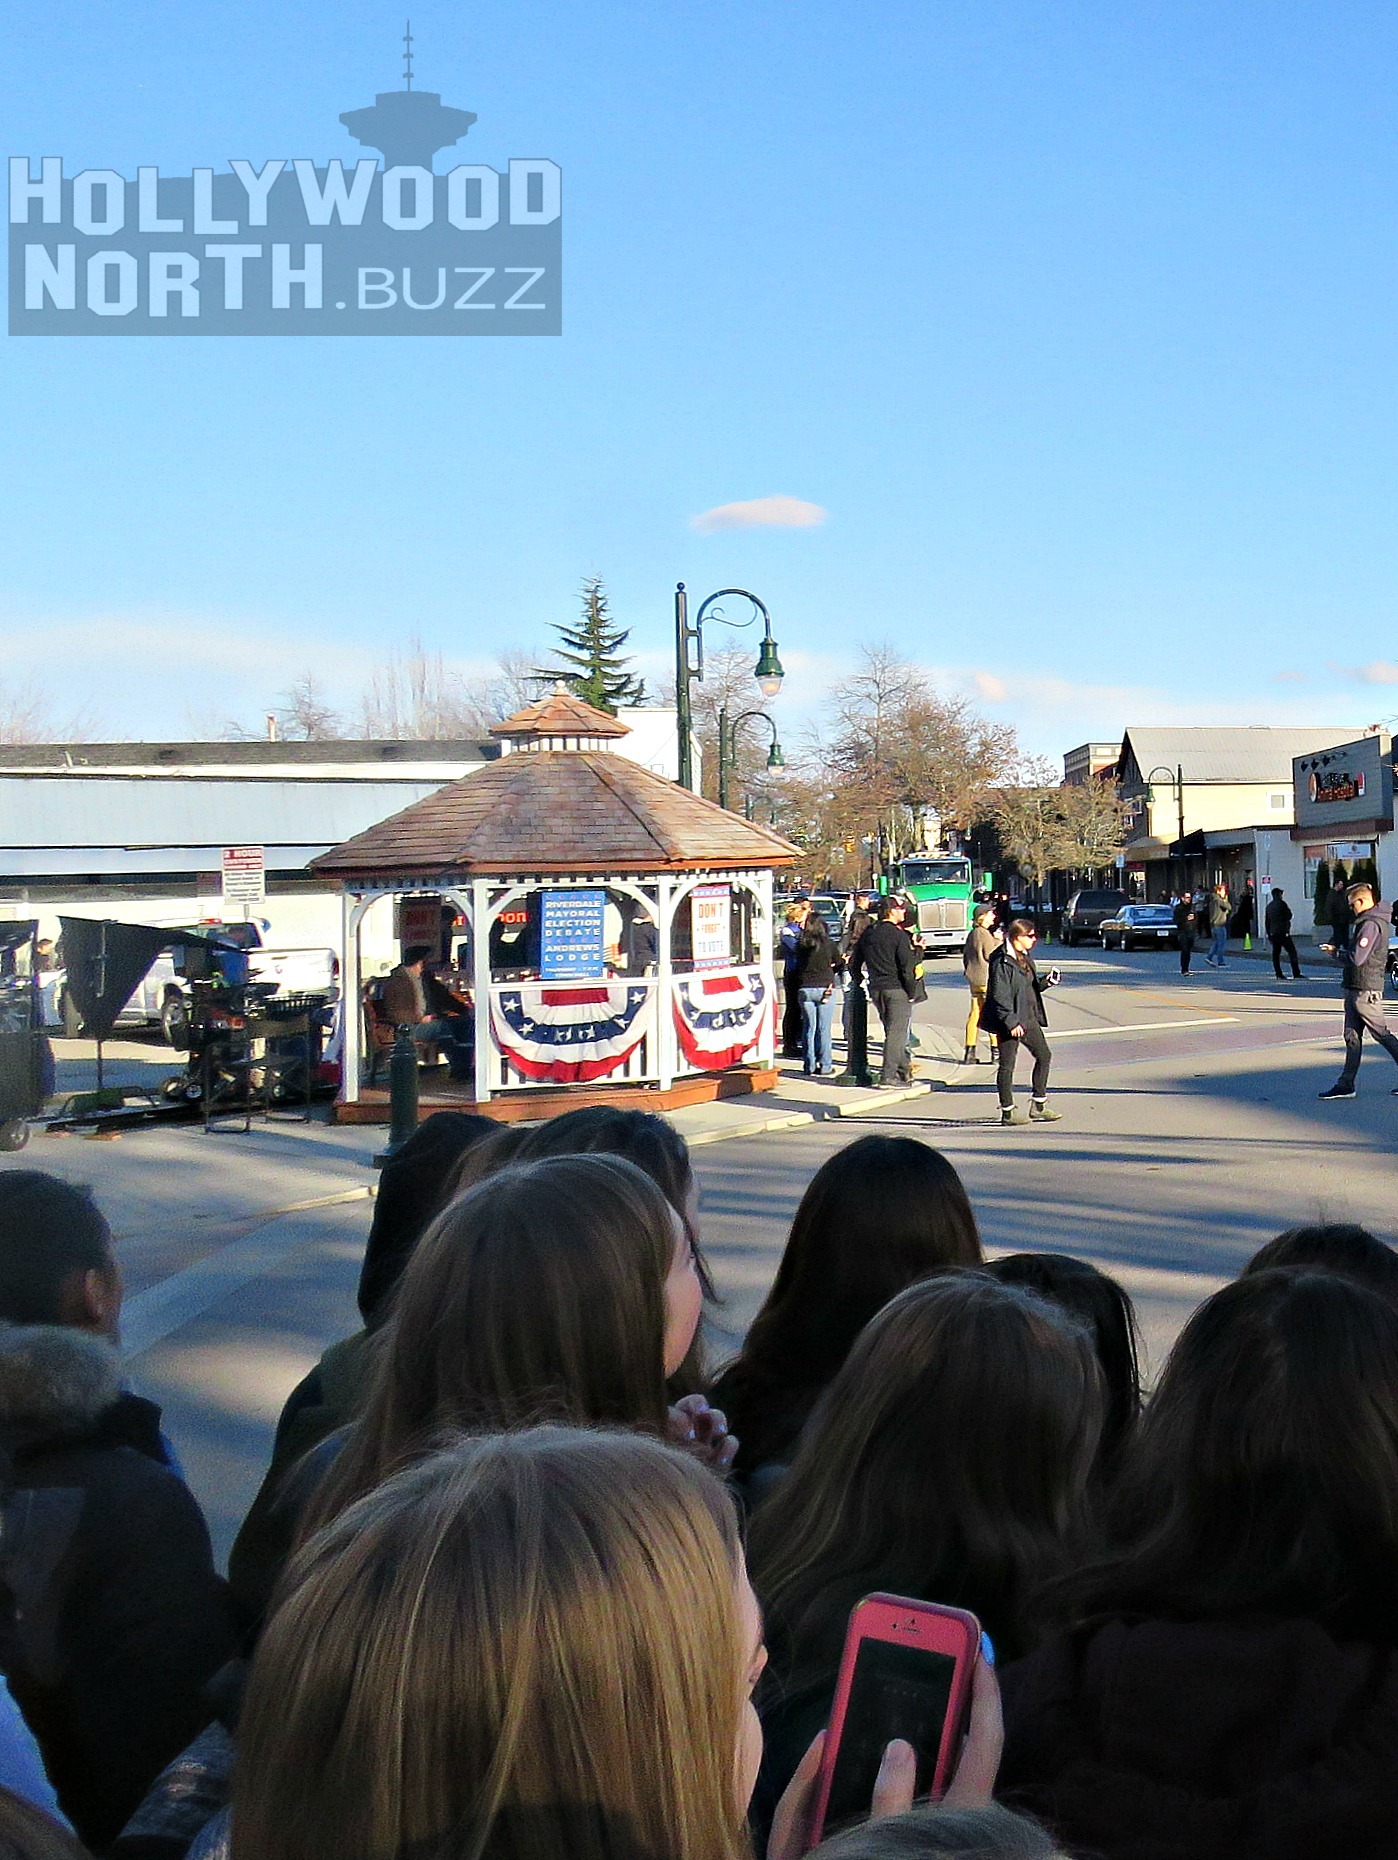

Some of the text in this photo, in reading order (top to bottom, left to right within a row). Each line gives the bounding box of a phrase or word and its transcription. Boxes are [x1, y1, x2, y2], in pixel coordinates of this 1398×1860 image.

[544, 919, 601, 927] ELECTION
[545, 928, 601, 936] DEBATE
[545, 944, 600, 952] ANDREWS
[544, 953, 601, 961] LODGE
